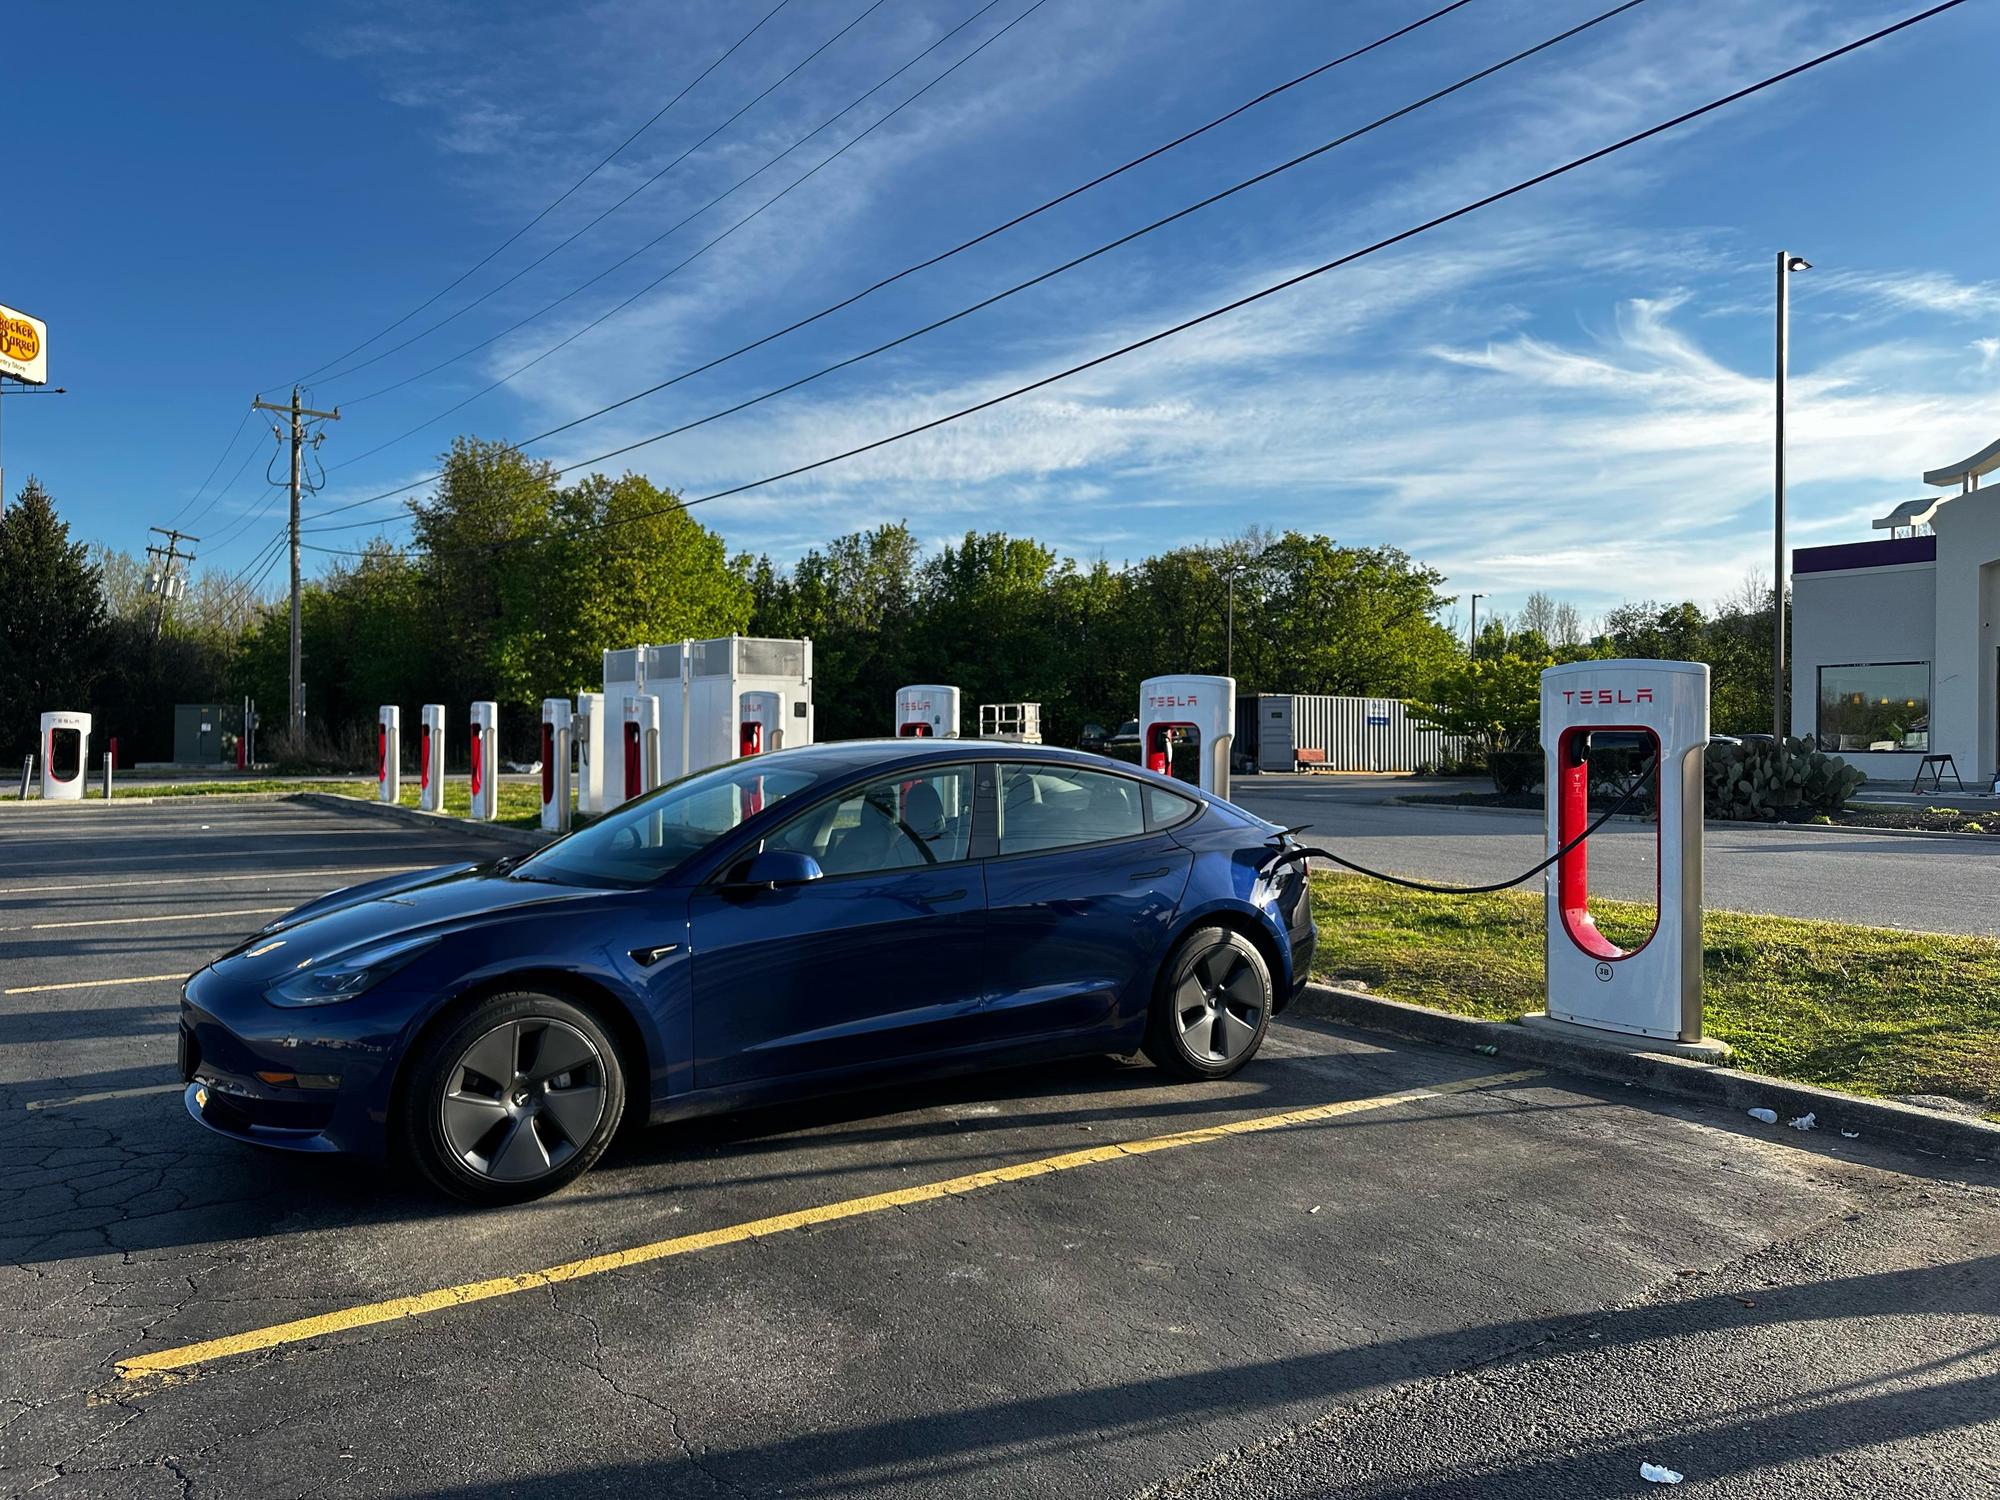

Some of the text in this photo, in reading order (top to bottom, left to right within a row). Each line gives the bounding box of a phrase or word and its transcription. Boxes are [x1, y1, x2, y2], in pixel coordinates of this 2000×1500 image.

[1149, 695, 1197, 707] TESLA
[1562, 688, 1653, 704] TESLA
[901, 701, 930, 711] TESLA
